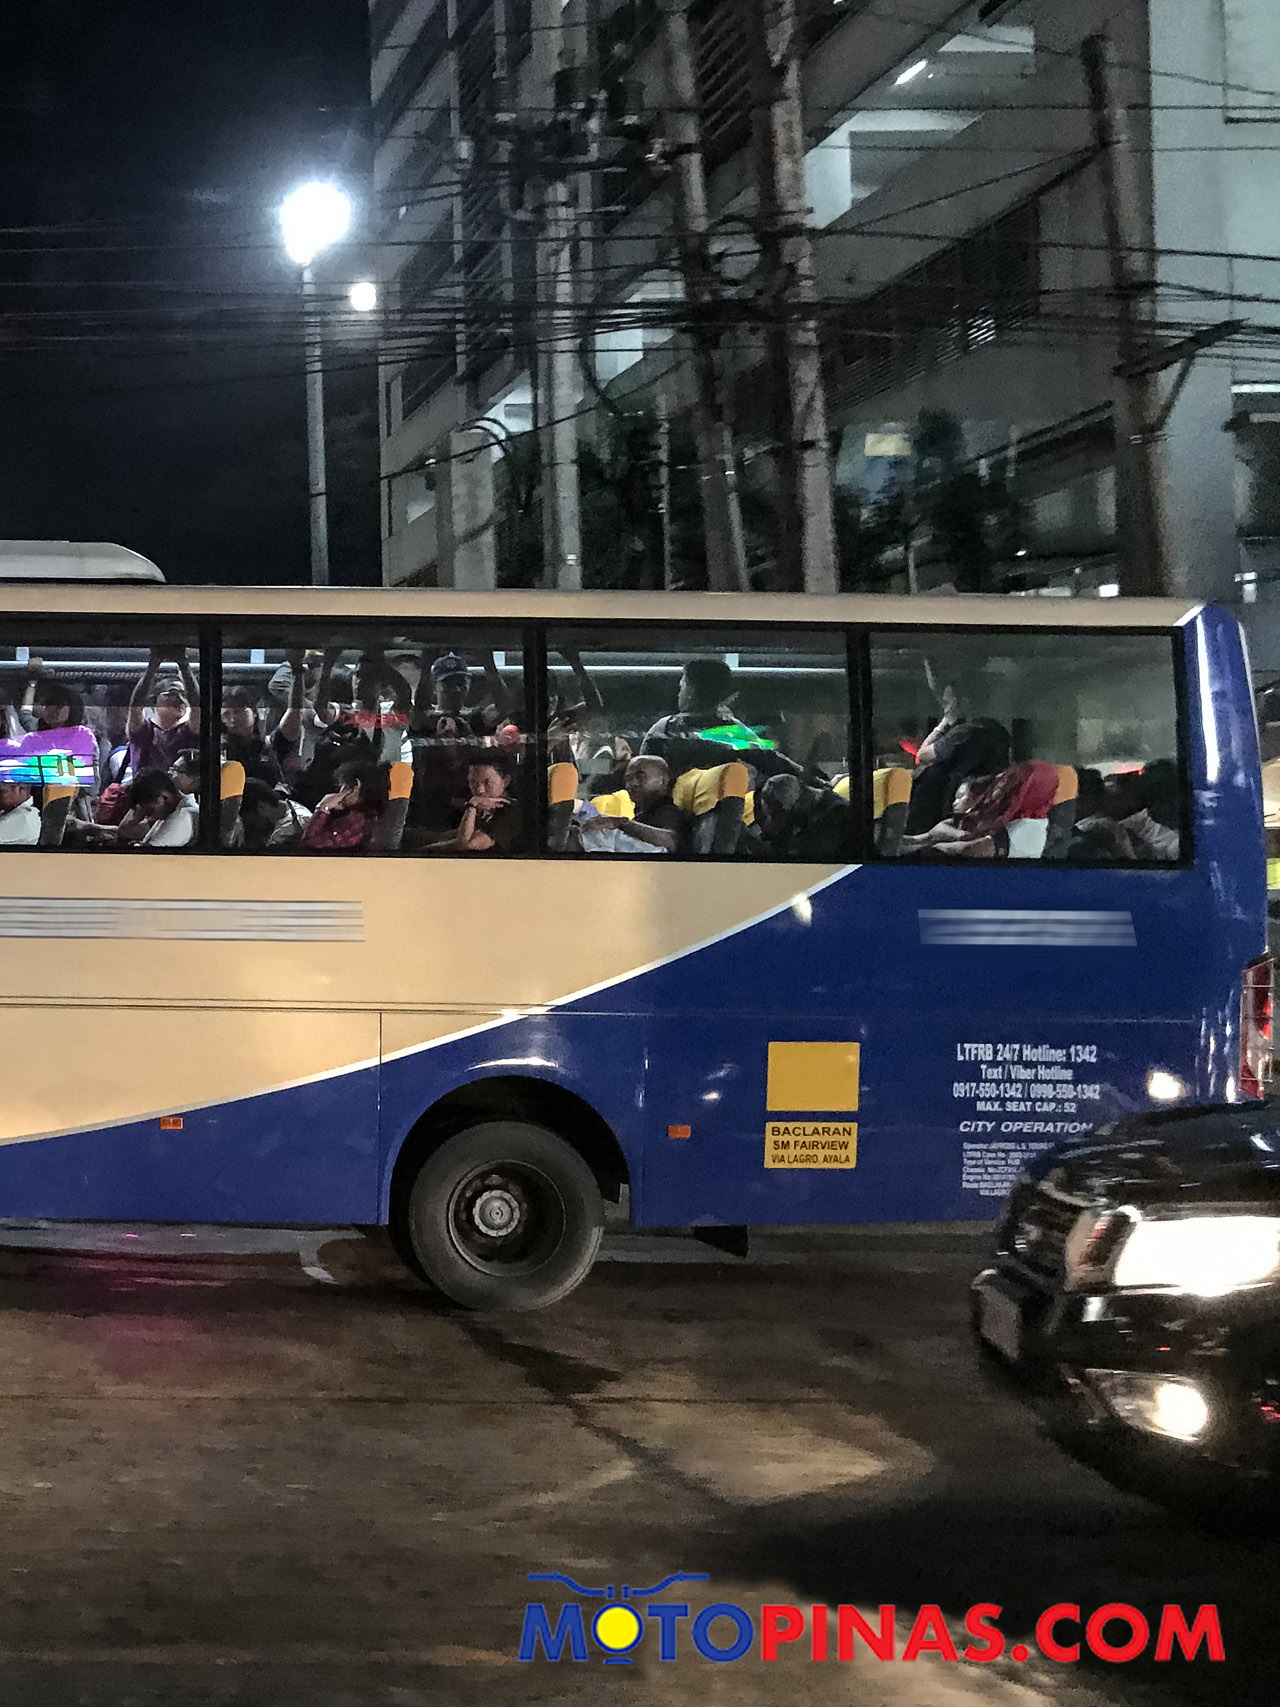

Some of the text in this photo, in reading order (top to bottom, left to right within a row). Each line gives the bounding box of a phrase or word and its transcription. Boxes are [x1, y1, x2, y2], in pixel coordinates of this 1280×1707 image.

[957, 1043, 1097, 1062] LTFRB 24/7 Hotline: 1342
[980, 1064, 1002, 1080] Text
[1009, 1065, 1036, 1080] Viber
[1037, 1065, 1073, 1080] Hotline
[952, 1082, 1023, 1098] 0917-550-1342
[976, 1101, 1002, 1112] MAX.
[1005, 1101, 1032, 1112] SEAT
[1063, 1102, 1077, 1113] 52
[771, 1126, 852, 1136] BACLARAN
[959, 1121, 996, 1133] CITY
[773, 1140, 849, 1151] SM FAIRVIEW
[771, 1154, 786, 1163] VIA
[823, 1155, 851, 1163] AYALA
